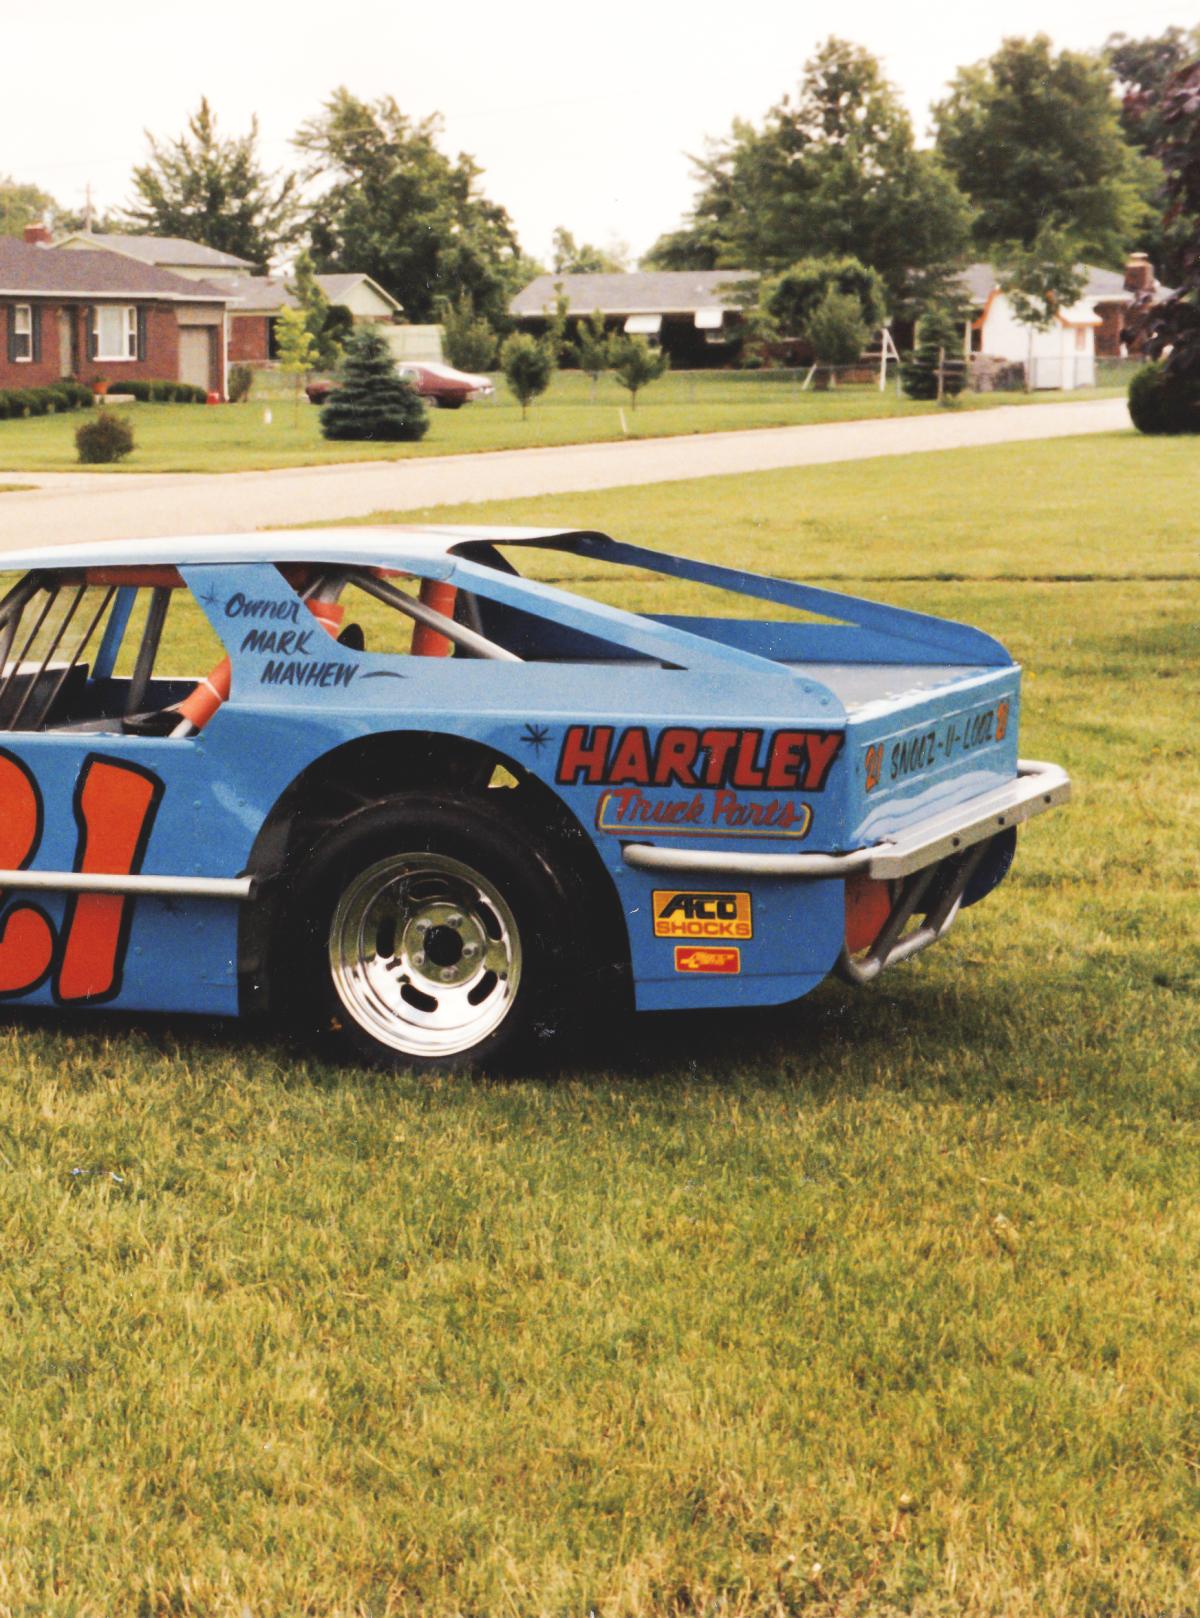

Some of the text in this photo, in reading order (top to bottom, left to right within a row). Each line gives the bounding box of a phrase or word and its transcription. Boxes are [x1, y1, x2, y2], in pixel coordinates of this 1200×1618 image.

[224, 592, 300, 624] Owner
[240, 629, 314, 656] MARK
[260, 660, 360, 688] MAYHEW
[555, 724, 846, 792] HARTLEY
[864, 741, 884, 794] 21
[611, 787, 803, 828] Truck Parts
[656, 921, 751, 936] SHOCKS
